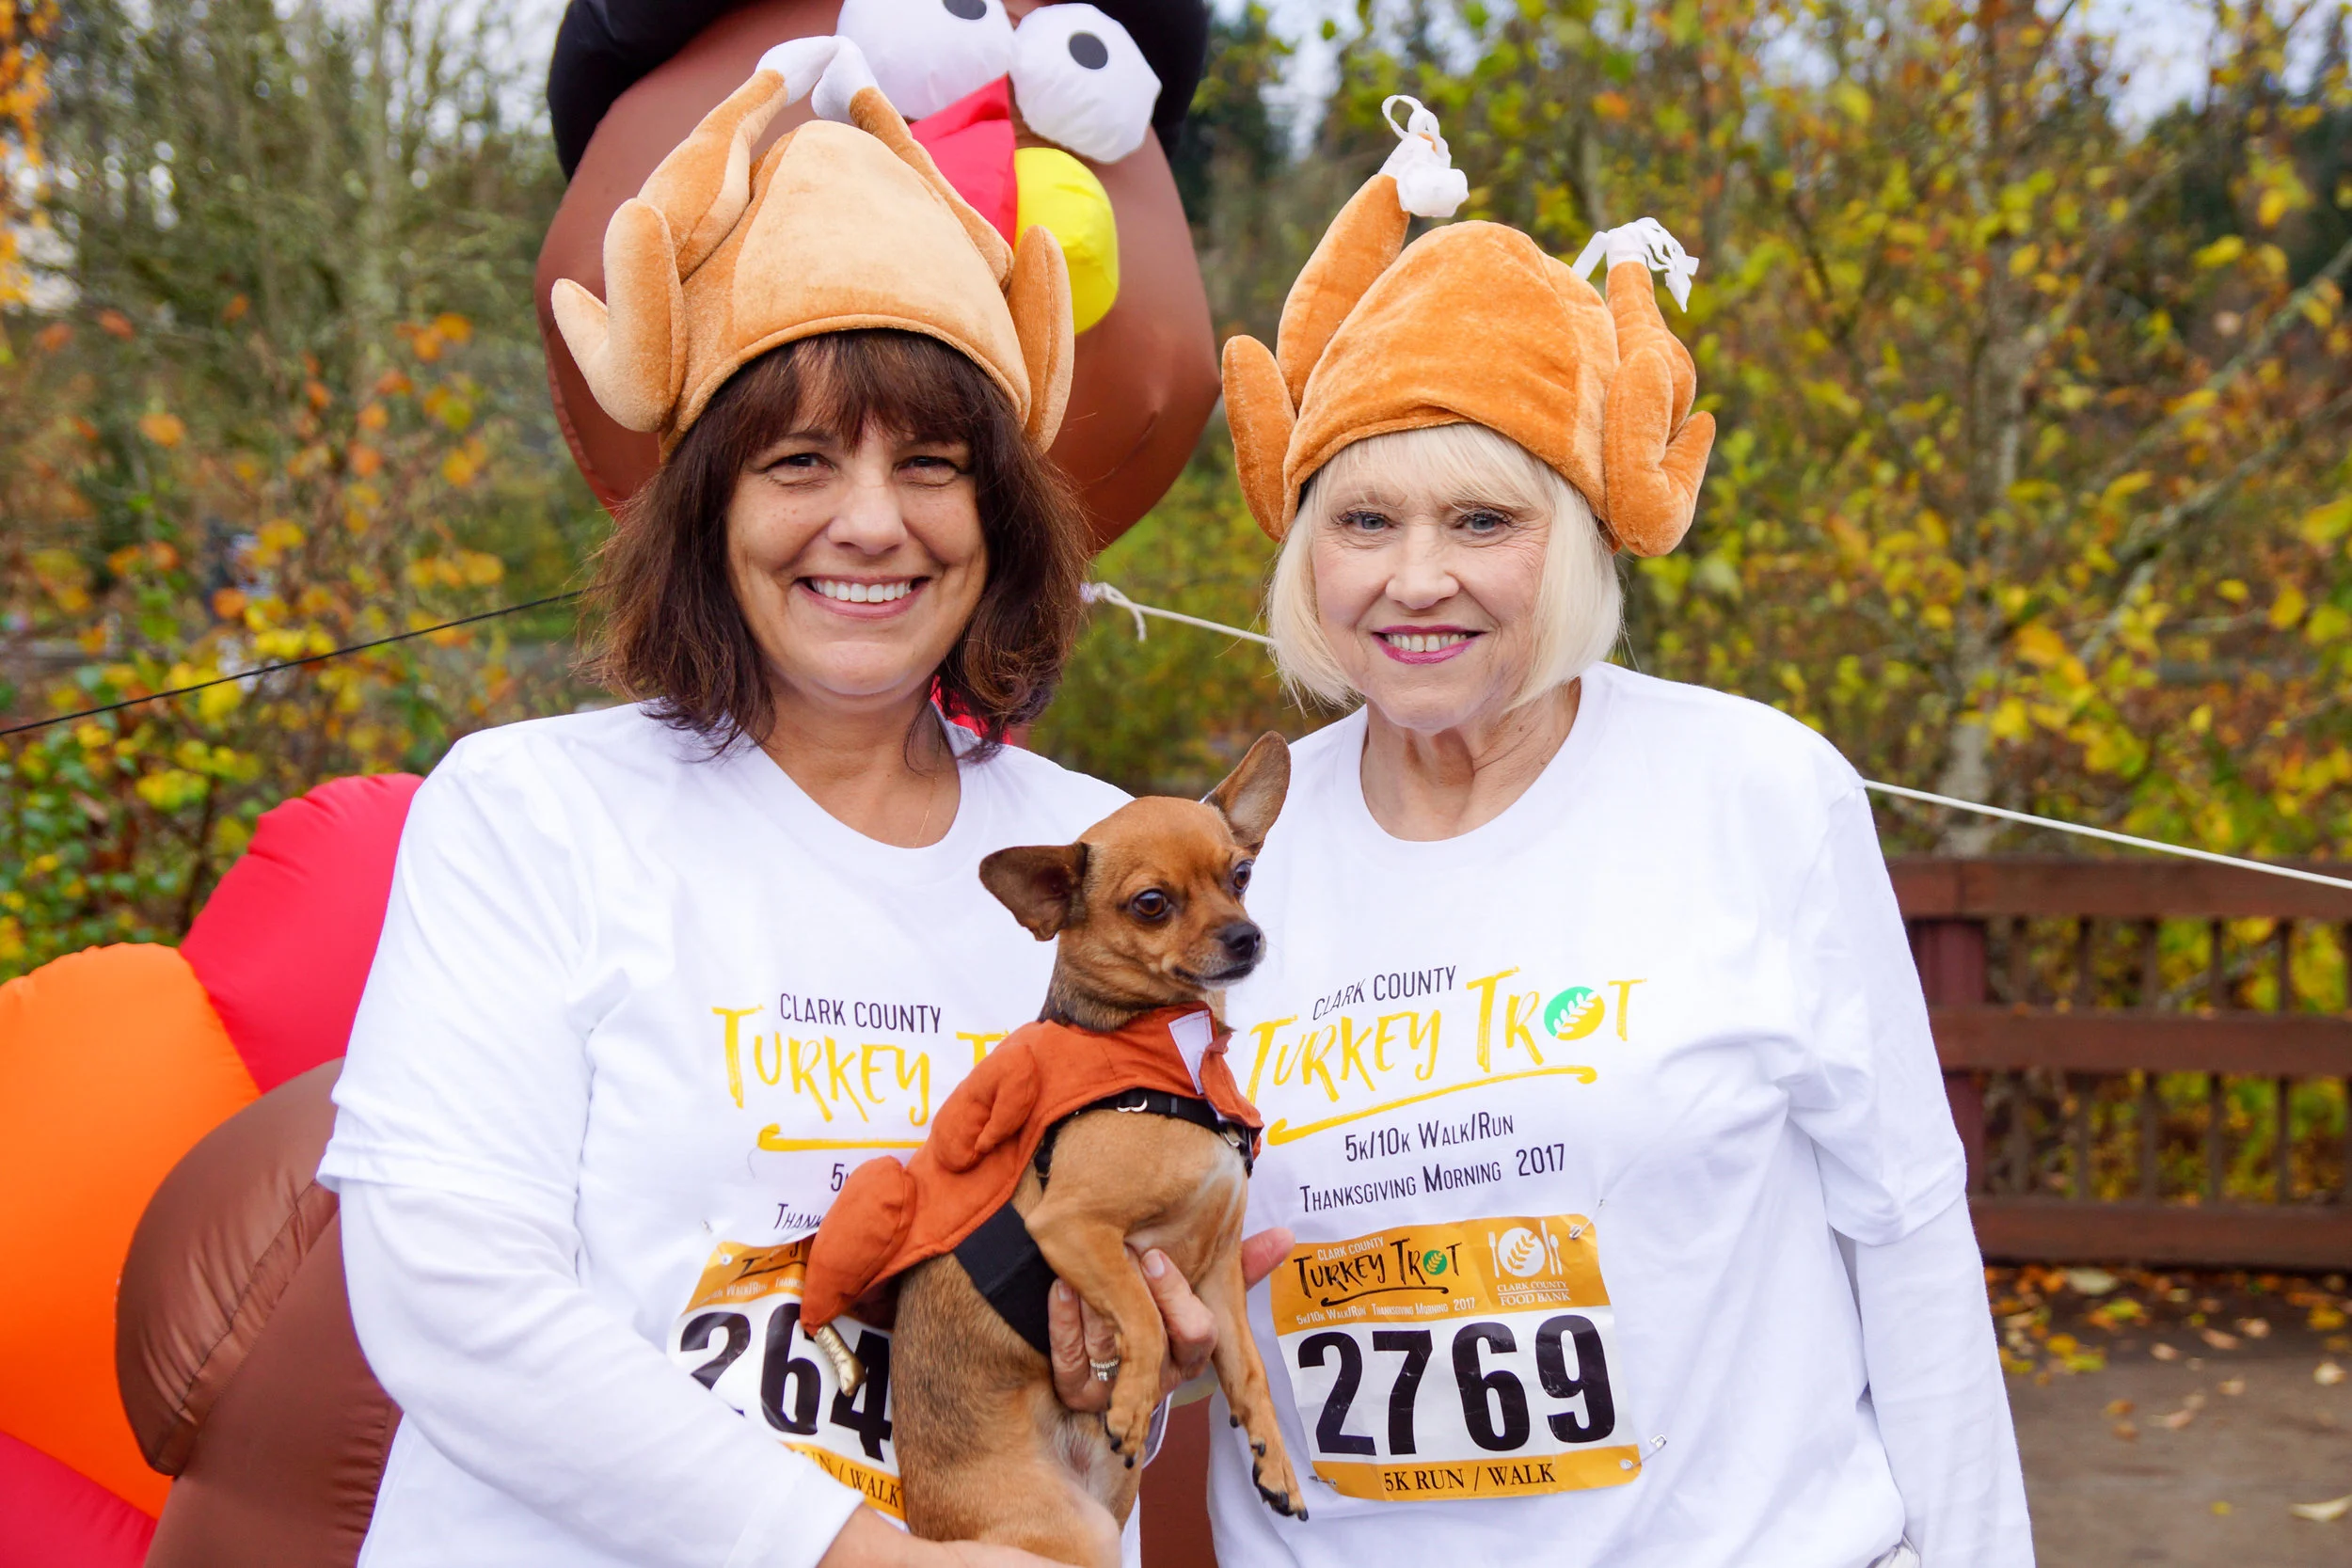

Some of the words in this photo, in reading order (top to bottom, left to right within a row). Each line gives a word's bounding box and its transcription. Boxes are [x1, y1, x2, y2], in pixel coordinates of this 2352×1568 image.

[780, 992, 846, 1026] CLARK
[854, 1001, 942, 1034] COUNTY
[1312, 977, 1366, 1022] CLARK
[1374, 964, 1456, 1000] COUNTY
[1246, 1008, 1442, 1107] TURKEY
[1466, 965, 1646, 1074] TROT
[711, 1004, 931, 1127] TURKEY
[1418, 1111, 1515, 1149] WALK/RUN
[1299, 1174, 1417, 1213] THANKSGIVING
[1422, 1160, 1502, 1194] MORNING
[1516, 1143, 1566, 1178] 2017
[1293, 1253, 1386, 1299] TURKEY
[1390, 1237, 1463, 1286] TROT
[1317, 1246, 1347, 1261] CLARK
[1348, 1236, 1385, 1256] COUNTY
[1497, 1282, 1530, 1292] CLARK
[1531, 1280, 1567, 1291] COUNTY
[1499, 1292, 1535, 1307] FOOD
[1536, 1291, 1571, 1303] BANK
[1327, 1304, 1367, 1321] WALK/RUN
[1371, 1303, 1415, 1317] THANKSGIVING
[1415, 1302, 1450, 1316] MORNING
[1453, 1297, 1476, 1312] 2017
[1297, 1313, 1615, 1457] 2769
[850, 1467, 902, 1509] WALK
[1384, 1470, 1410, 1492] 5K
[1414, 1467, 1465, 1491] RUN
[1473, 1465, 1481, 1492] /
[1487, 1463, 1557, 1486] WALK
